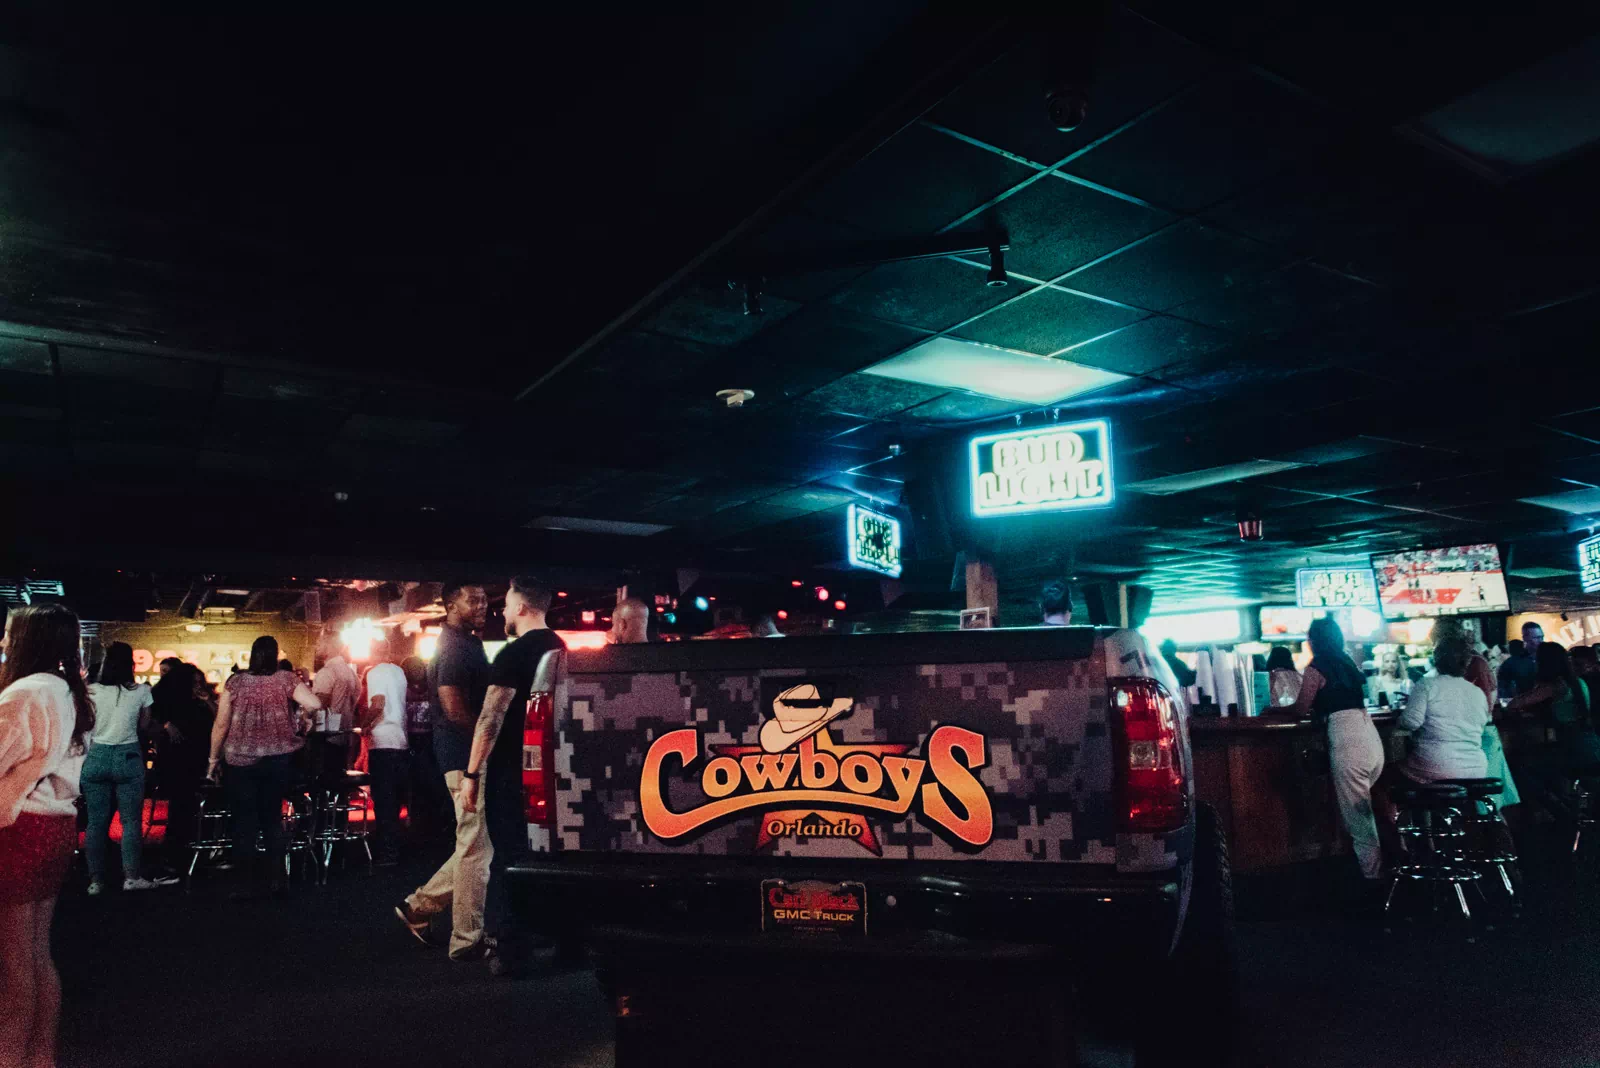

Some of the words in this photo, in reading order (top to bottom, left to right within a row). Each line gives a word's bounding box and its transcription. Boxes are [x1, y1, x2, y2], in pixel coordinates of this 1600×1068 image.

[992, 432, 1084, 475] BUD
[766, 818, 862, 840] Orlando
[773, 908, 811, 920] GMC
[815, 910, 855, 922] TRUCK
